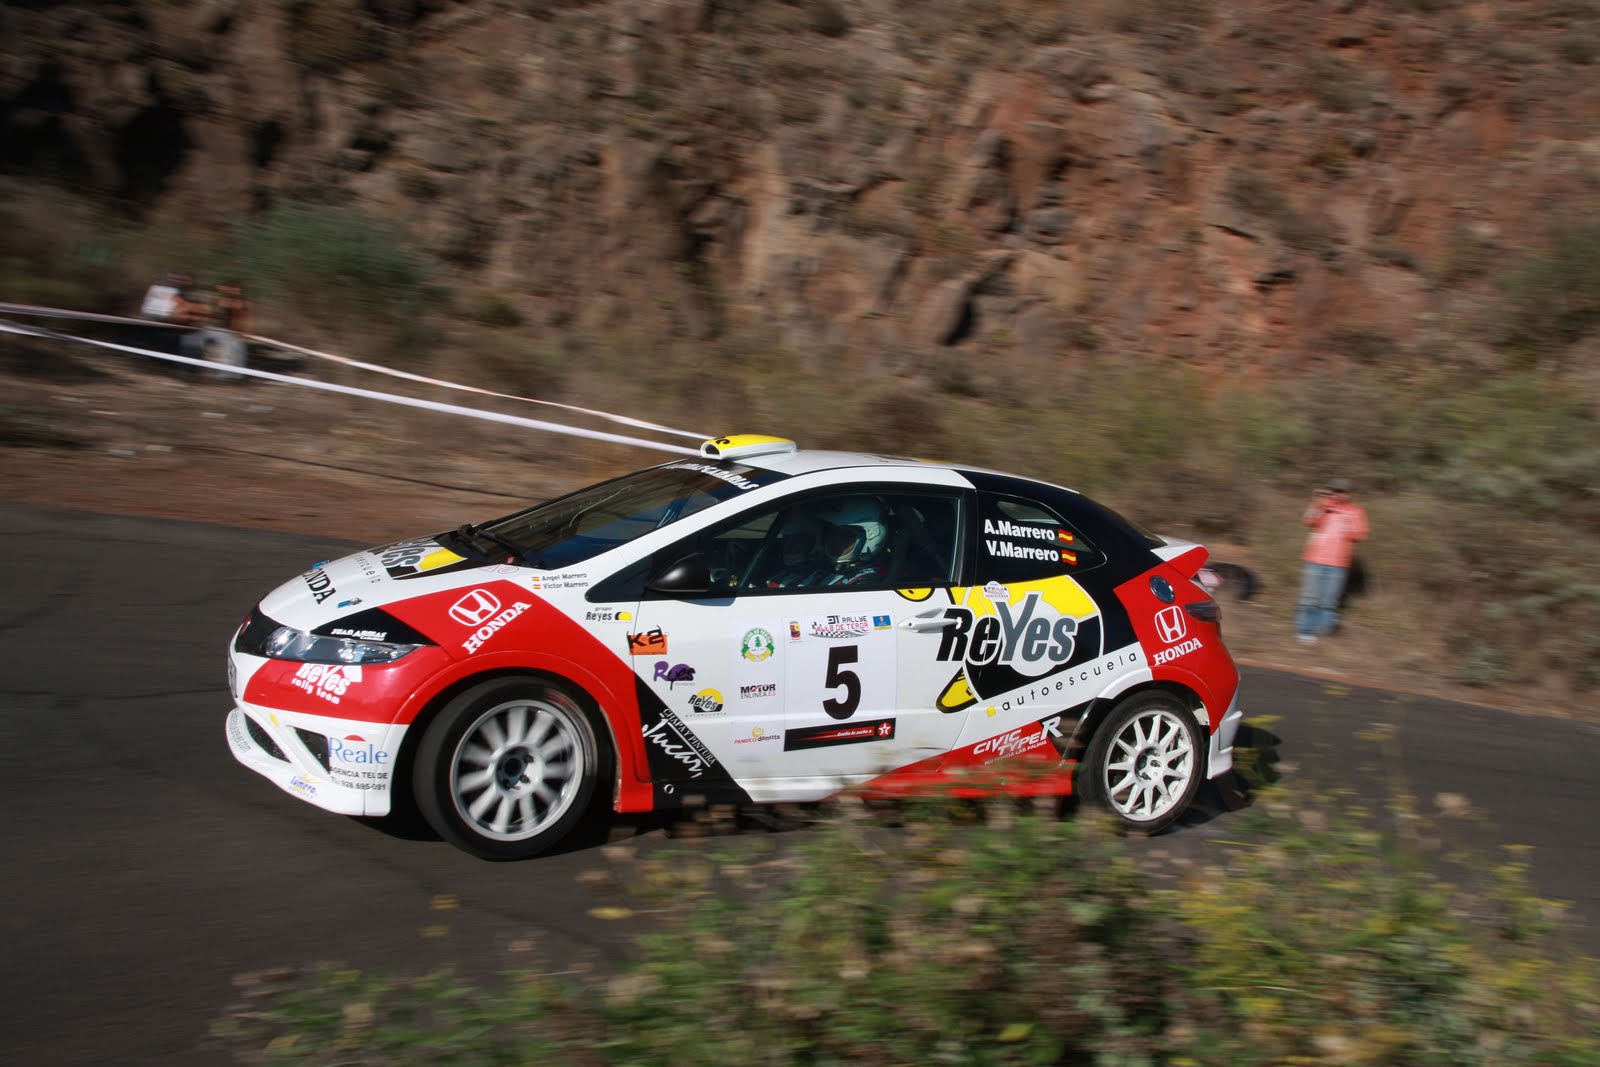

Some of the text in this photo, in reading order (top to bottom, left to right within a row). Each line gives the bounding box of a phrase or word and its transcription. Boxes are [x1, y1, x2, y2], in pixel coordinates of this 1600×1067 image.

[984, 519, 1056, 541] A.Marrero
[985, 539, 1060, 562] V.Marrero
[461, 601, 532, 655] HONDA
[585, 611, 613, 622] Reyes
[841, 615, 868, 623] RALLYE
[847, 620, 869, 630] TEROR
[1152, 637, 1203, 666] HONDA
[291, 677, 341, 705] rally team
[740, 683, 776, 694] MOTOR
[822, 644, 862, 720] 5
[1001, 651, 1137, 710] autoescuela
[662, 708, 686, 732] CHAPA
[688, 735, 716, 765] PINTURA
[973, 729, 1022, 755] CIVIC
[998, 716, 1063, 756] TYPE R
[1015, 747, 1027, 755] LAS
[1027, 740, 1047, 751] PALMAS
[328, 737, 388, 765] Reale
